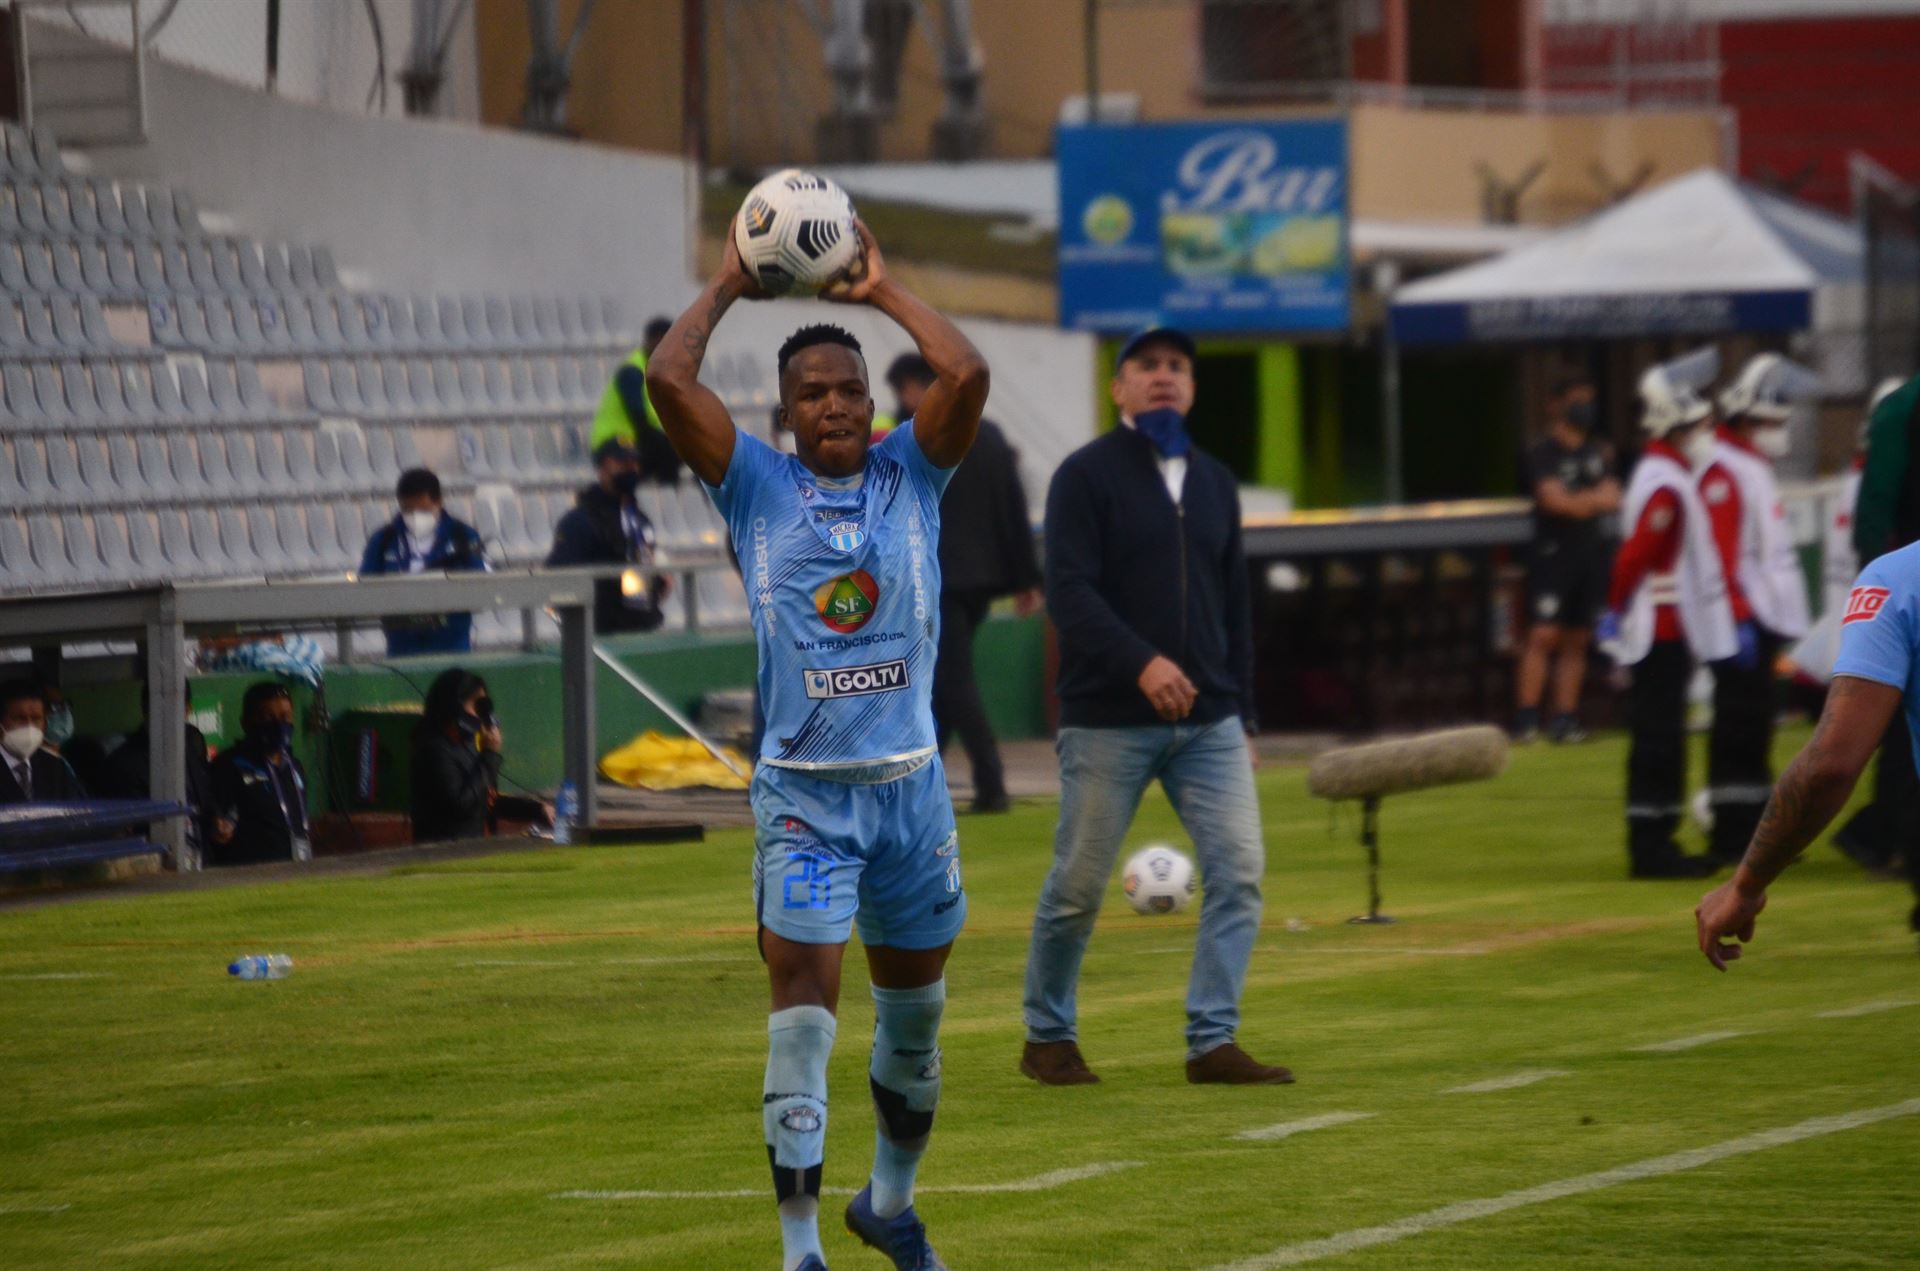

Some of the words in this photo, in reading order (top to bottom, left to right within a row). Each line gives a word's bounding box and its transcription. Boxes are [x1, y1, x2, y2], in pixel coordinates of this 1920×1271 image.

[754, 517, 769, 589] austro
[912, 551, 926, 620] austro
[835, 597, 861, 614] SF
[819, 632, 888, 651] FRANCISCO
[835, 665, 900, 691] GOLTV
